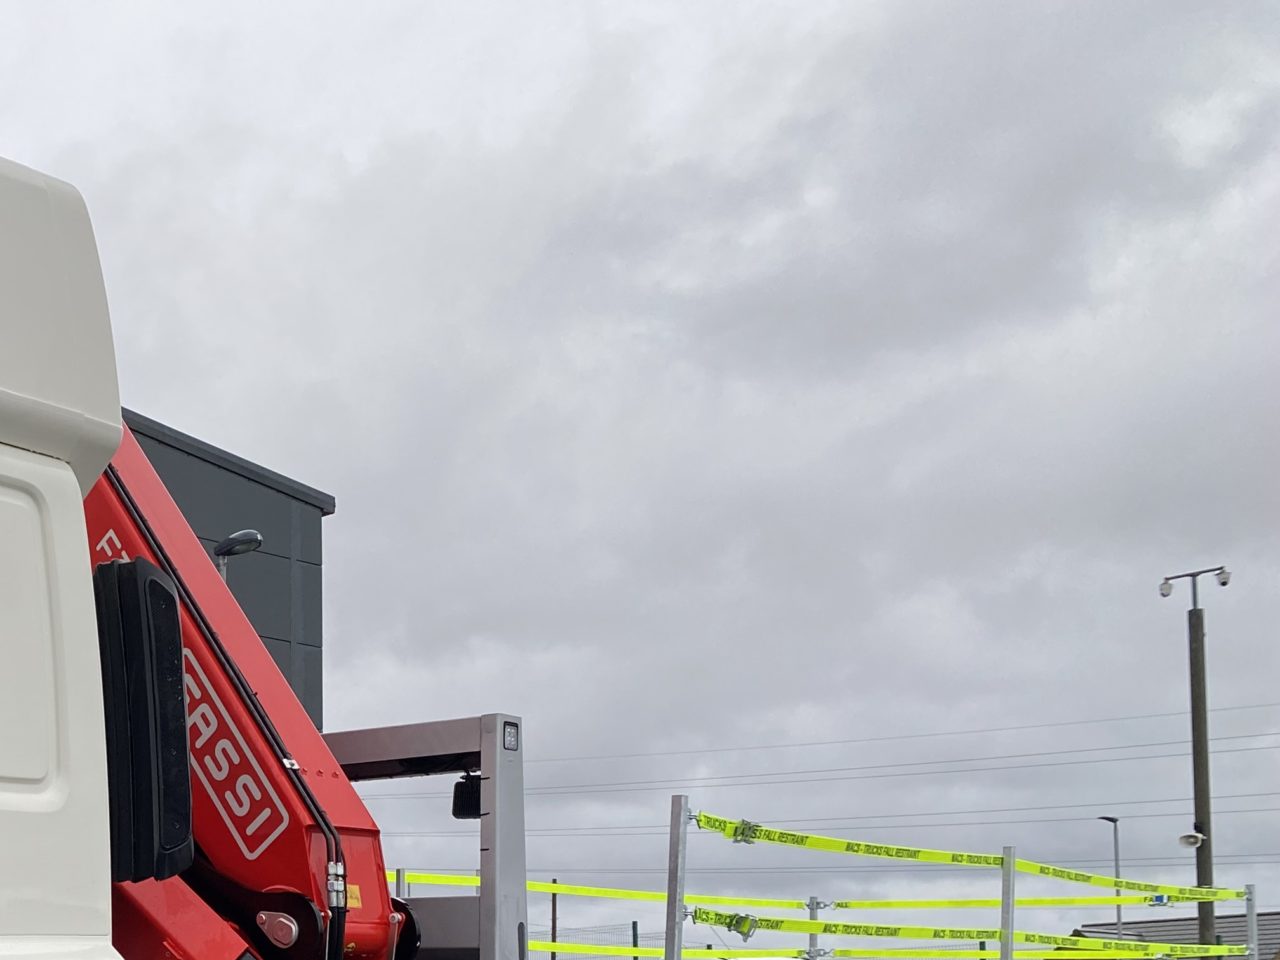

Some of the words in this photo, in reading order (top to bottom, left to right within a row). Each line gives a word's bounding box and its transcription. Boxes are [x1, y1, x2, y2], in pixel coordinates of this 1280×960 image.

[702, 814, 727, 832] TRUCKS
[763, 830, 776, 841] FALL
[778, 832, 809, 846] RESTRAINT
[845, 842, 861, 852] MACS
[864, 844, 883, 856] TRUCKS
[823, 923, 839, 933] MACS
[842, 925, 862, 935] TRUCKS
[862, 926, 874, 935] FALL
[875, 927, 900, 936] RESTRAINT
